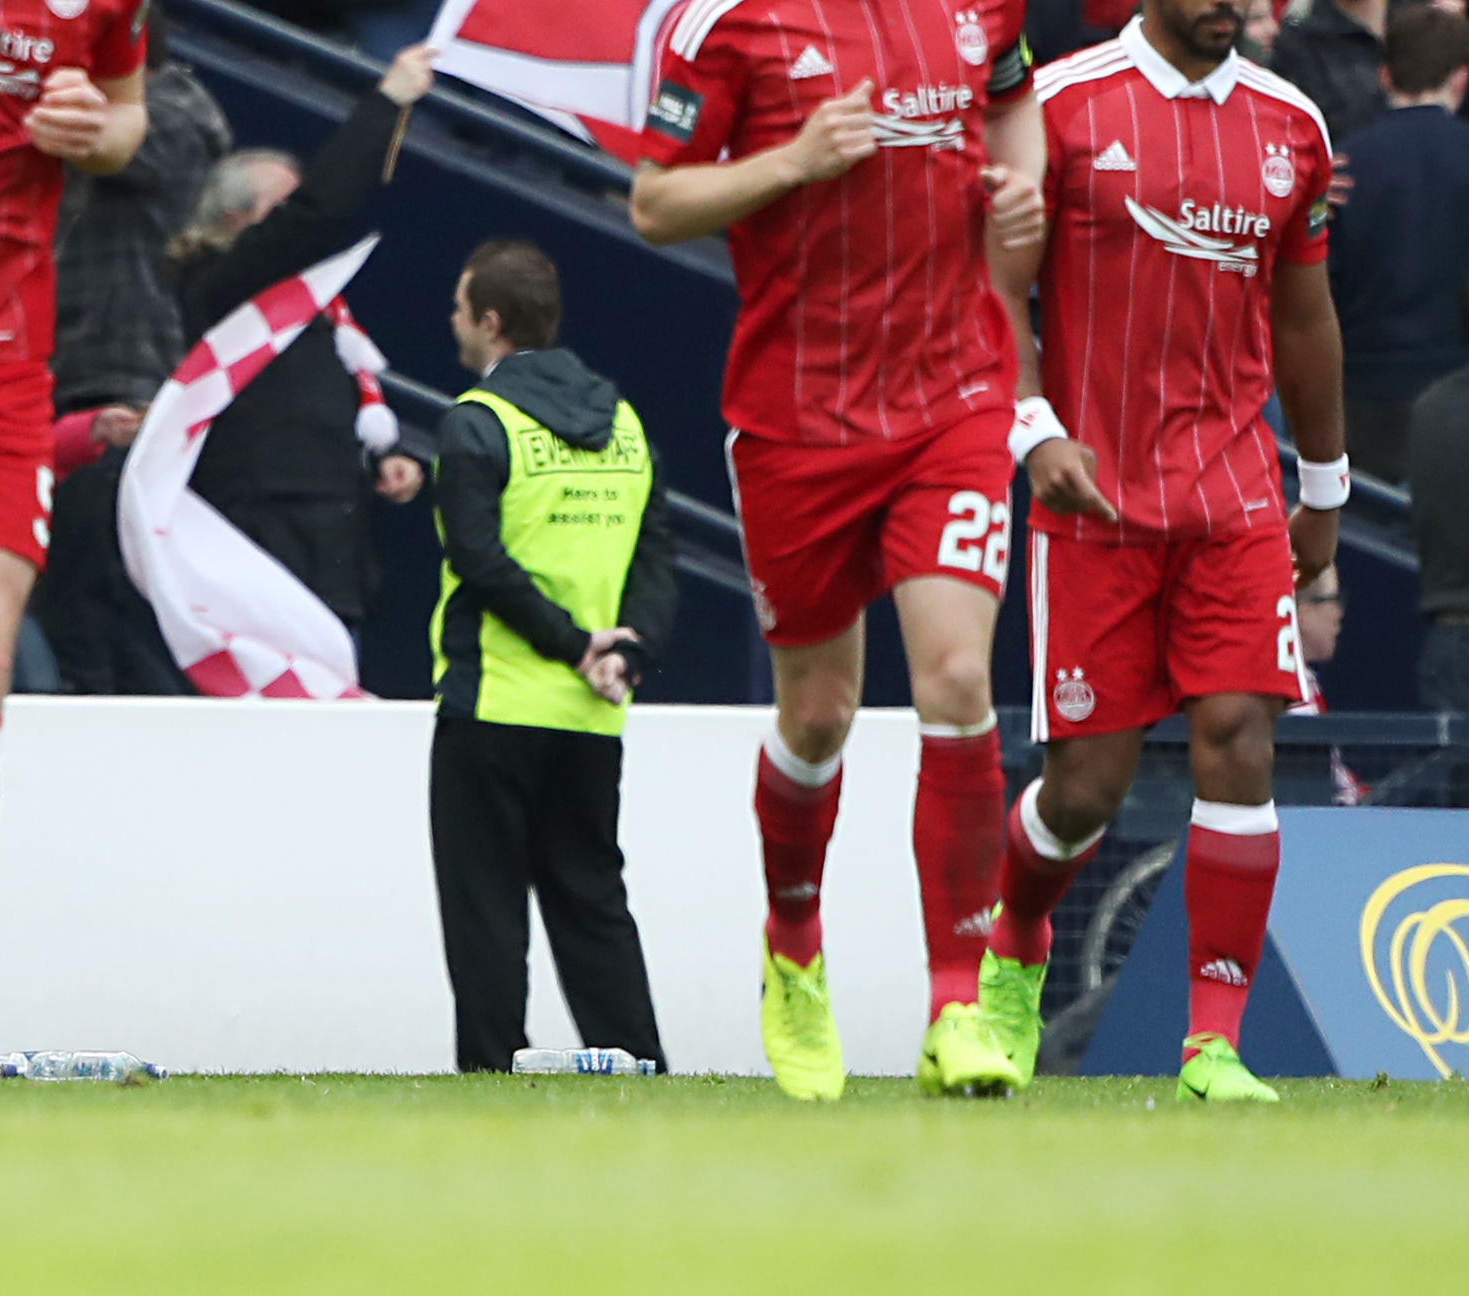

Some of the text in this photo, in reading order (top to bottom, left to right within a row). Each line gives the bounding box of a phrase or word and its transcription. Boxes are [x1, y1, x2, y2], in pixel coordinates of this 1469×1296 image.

[883, 83, 973, 120] Saltire
[1179, 198, 1271, 238] Saltire
[1217, 261, 1258, 278] energy
[938, 490, 1008, 583] 22
